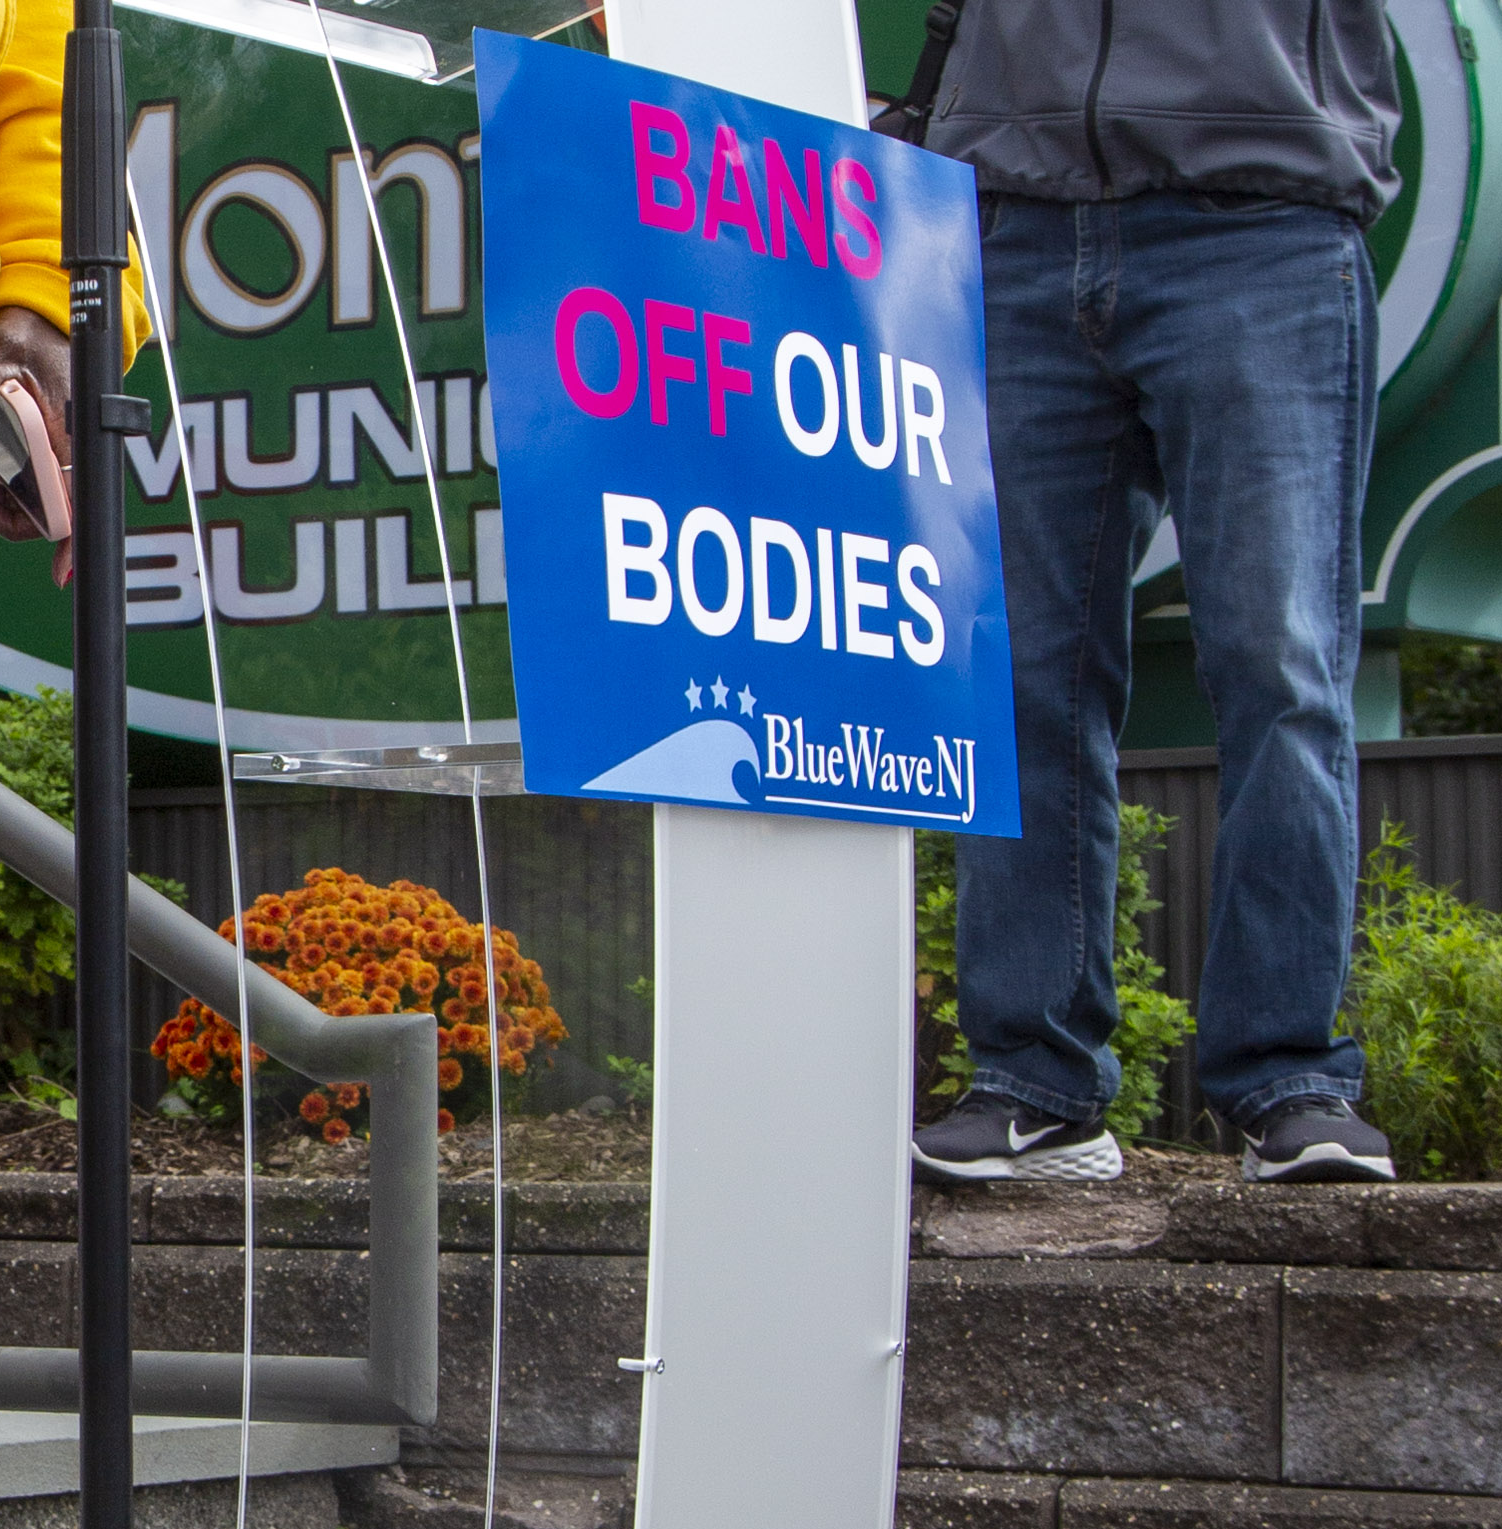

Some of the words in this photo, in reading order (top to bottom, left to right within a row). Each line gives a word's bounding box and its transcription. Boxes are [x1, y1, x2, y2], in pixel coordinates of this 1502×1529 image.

[126, 103, 483, 345] on
[629, 99, 885, 281] BANS
[70, 278, 99, 293] UDIO
[124, 375, 498, 499] MUNI
[554, 286, 754, 438] OFF
[773, 330, 954, 486] OUR
[601, 491, 946, 668] BODIES
[762, 712, 976, 824] BlueWaveNJ
